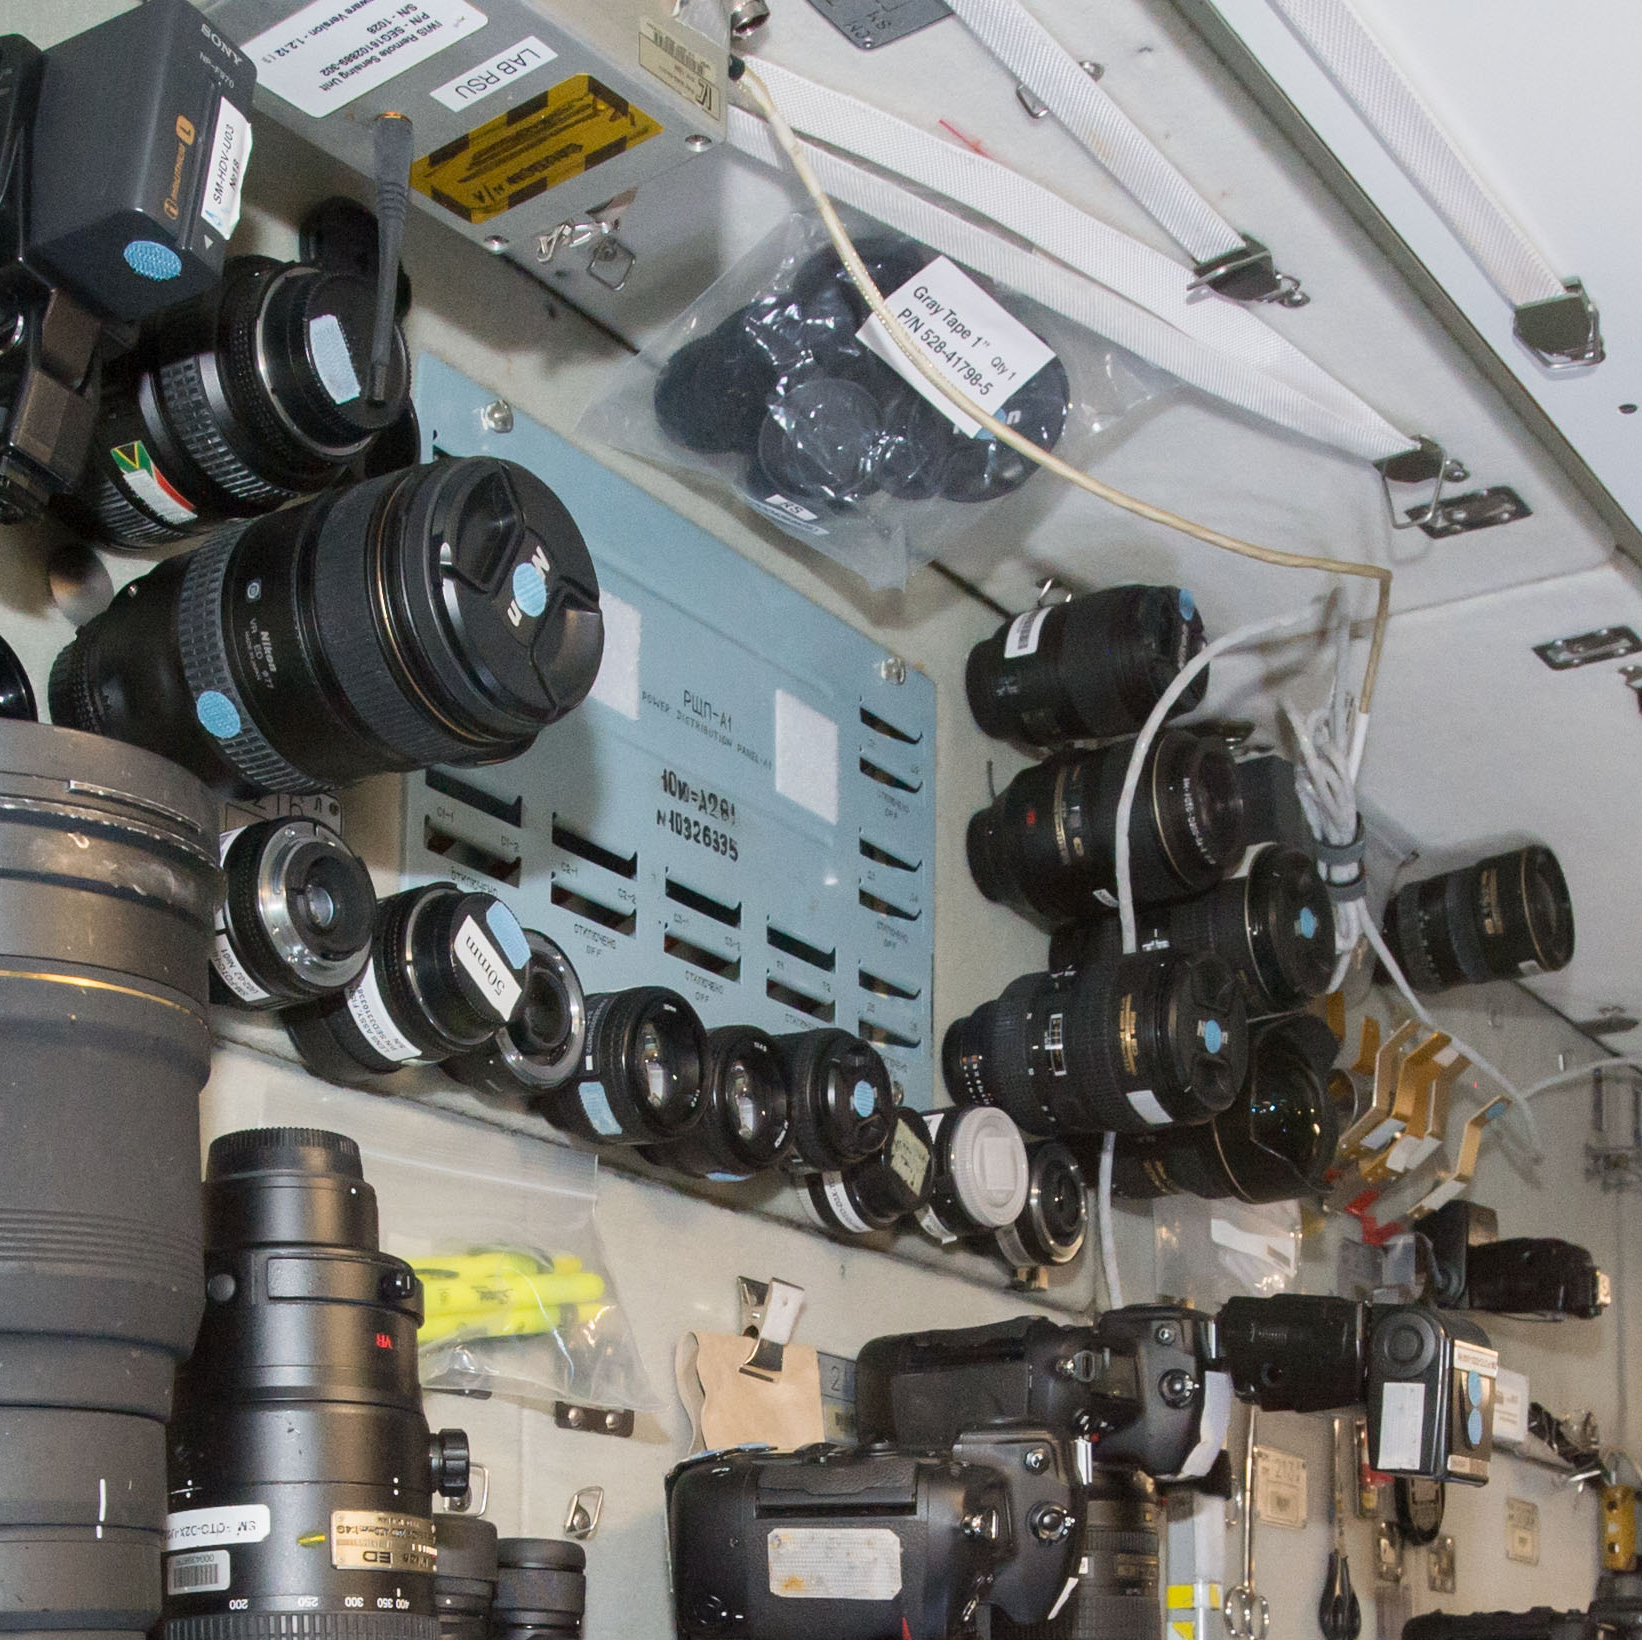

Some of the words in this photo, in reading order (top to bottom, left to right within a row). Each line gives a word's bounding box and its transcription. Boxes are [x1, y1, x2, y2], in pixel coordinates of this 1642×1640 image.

[200, 23, 243, 66] SONY
[497, 48, 541, 75] LAB
[455, 71, 499, 100] RSU
[913, 285, 945, 316] Gray
[940, 309, 972, 341] Tape
[897, 308, 922, 334] P/N
[920, 325, 994, 396] 528-41798-5
[990, 355, 1008, 377] Qty
[257, 629, 280, 673] Nikon
[642, 690, 670, 713] POWER
[677, 710, 734, 748] DISTRIBUTION
[465, 935, 506, 996] 50mm
[375, 1333, 393, 1349] VR
[229, 1599, 249, 1610] 200
[298, 1597, 319, 1608] 250
[345, 1597, 364, 1608] 300
[377, 1598, 393, 1609] 350
[396, 1600, 410, 1610] 400
